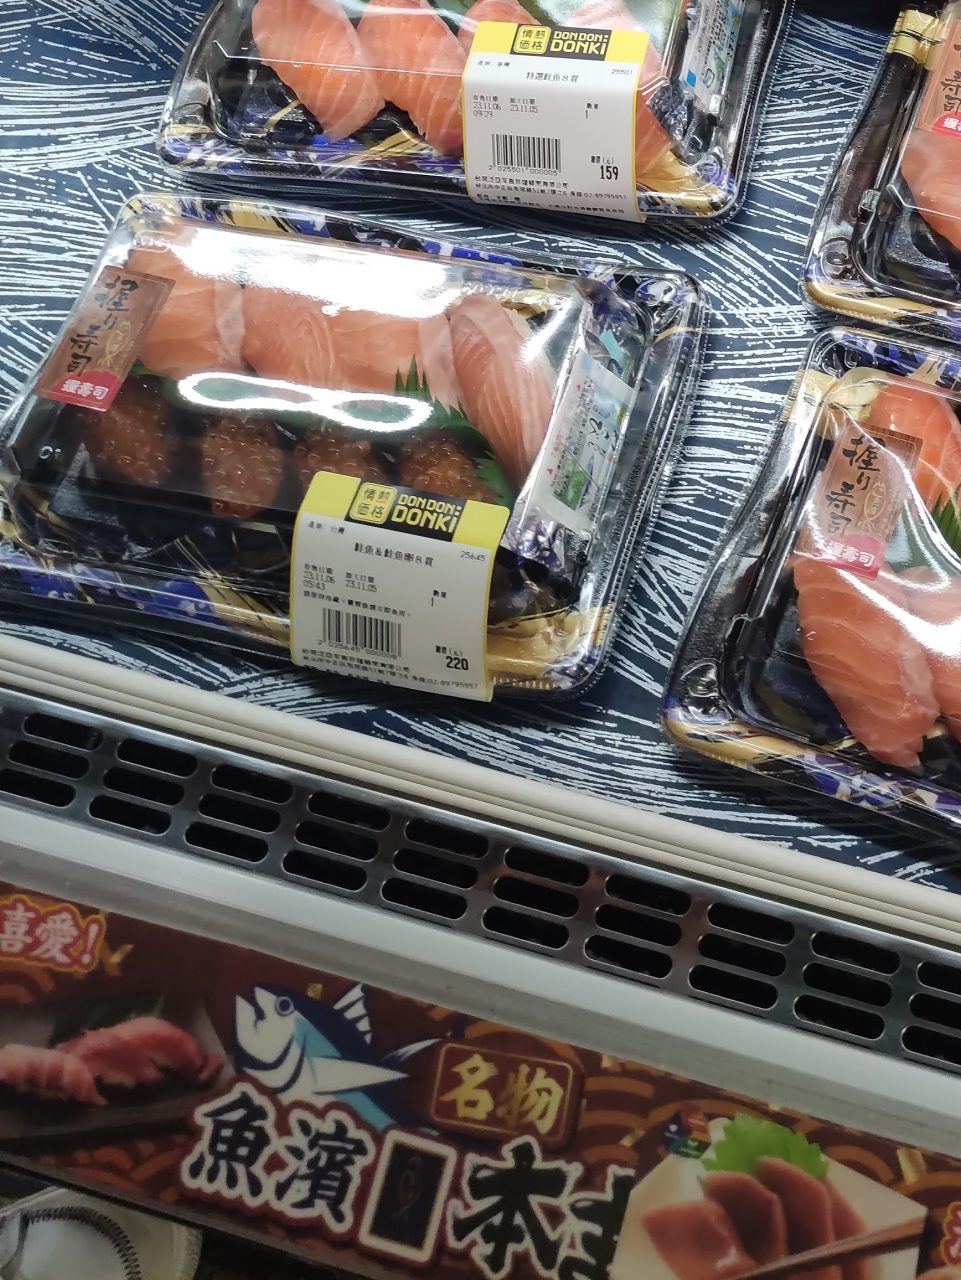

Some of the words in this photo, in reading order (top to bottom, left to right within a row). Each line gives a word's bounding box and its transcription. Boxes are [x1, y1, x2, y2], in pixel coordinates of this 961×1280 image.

[510, 103, 538, 114] 23.11.05
[600, 165, 619, 180] 159
[460, 550, 486, 562] 25645
[303, 571, 336, 585] 23.11.06
[345, 579, 378, 593] 23.11.05
[445, 655, 469, 671] 220
[438, 1053, 564, 1135] 名物
[188, 1090, 368, 1224] 魚濱
